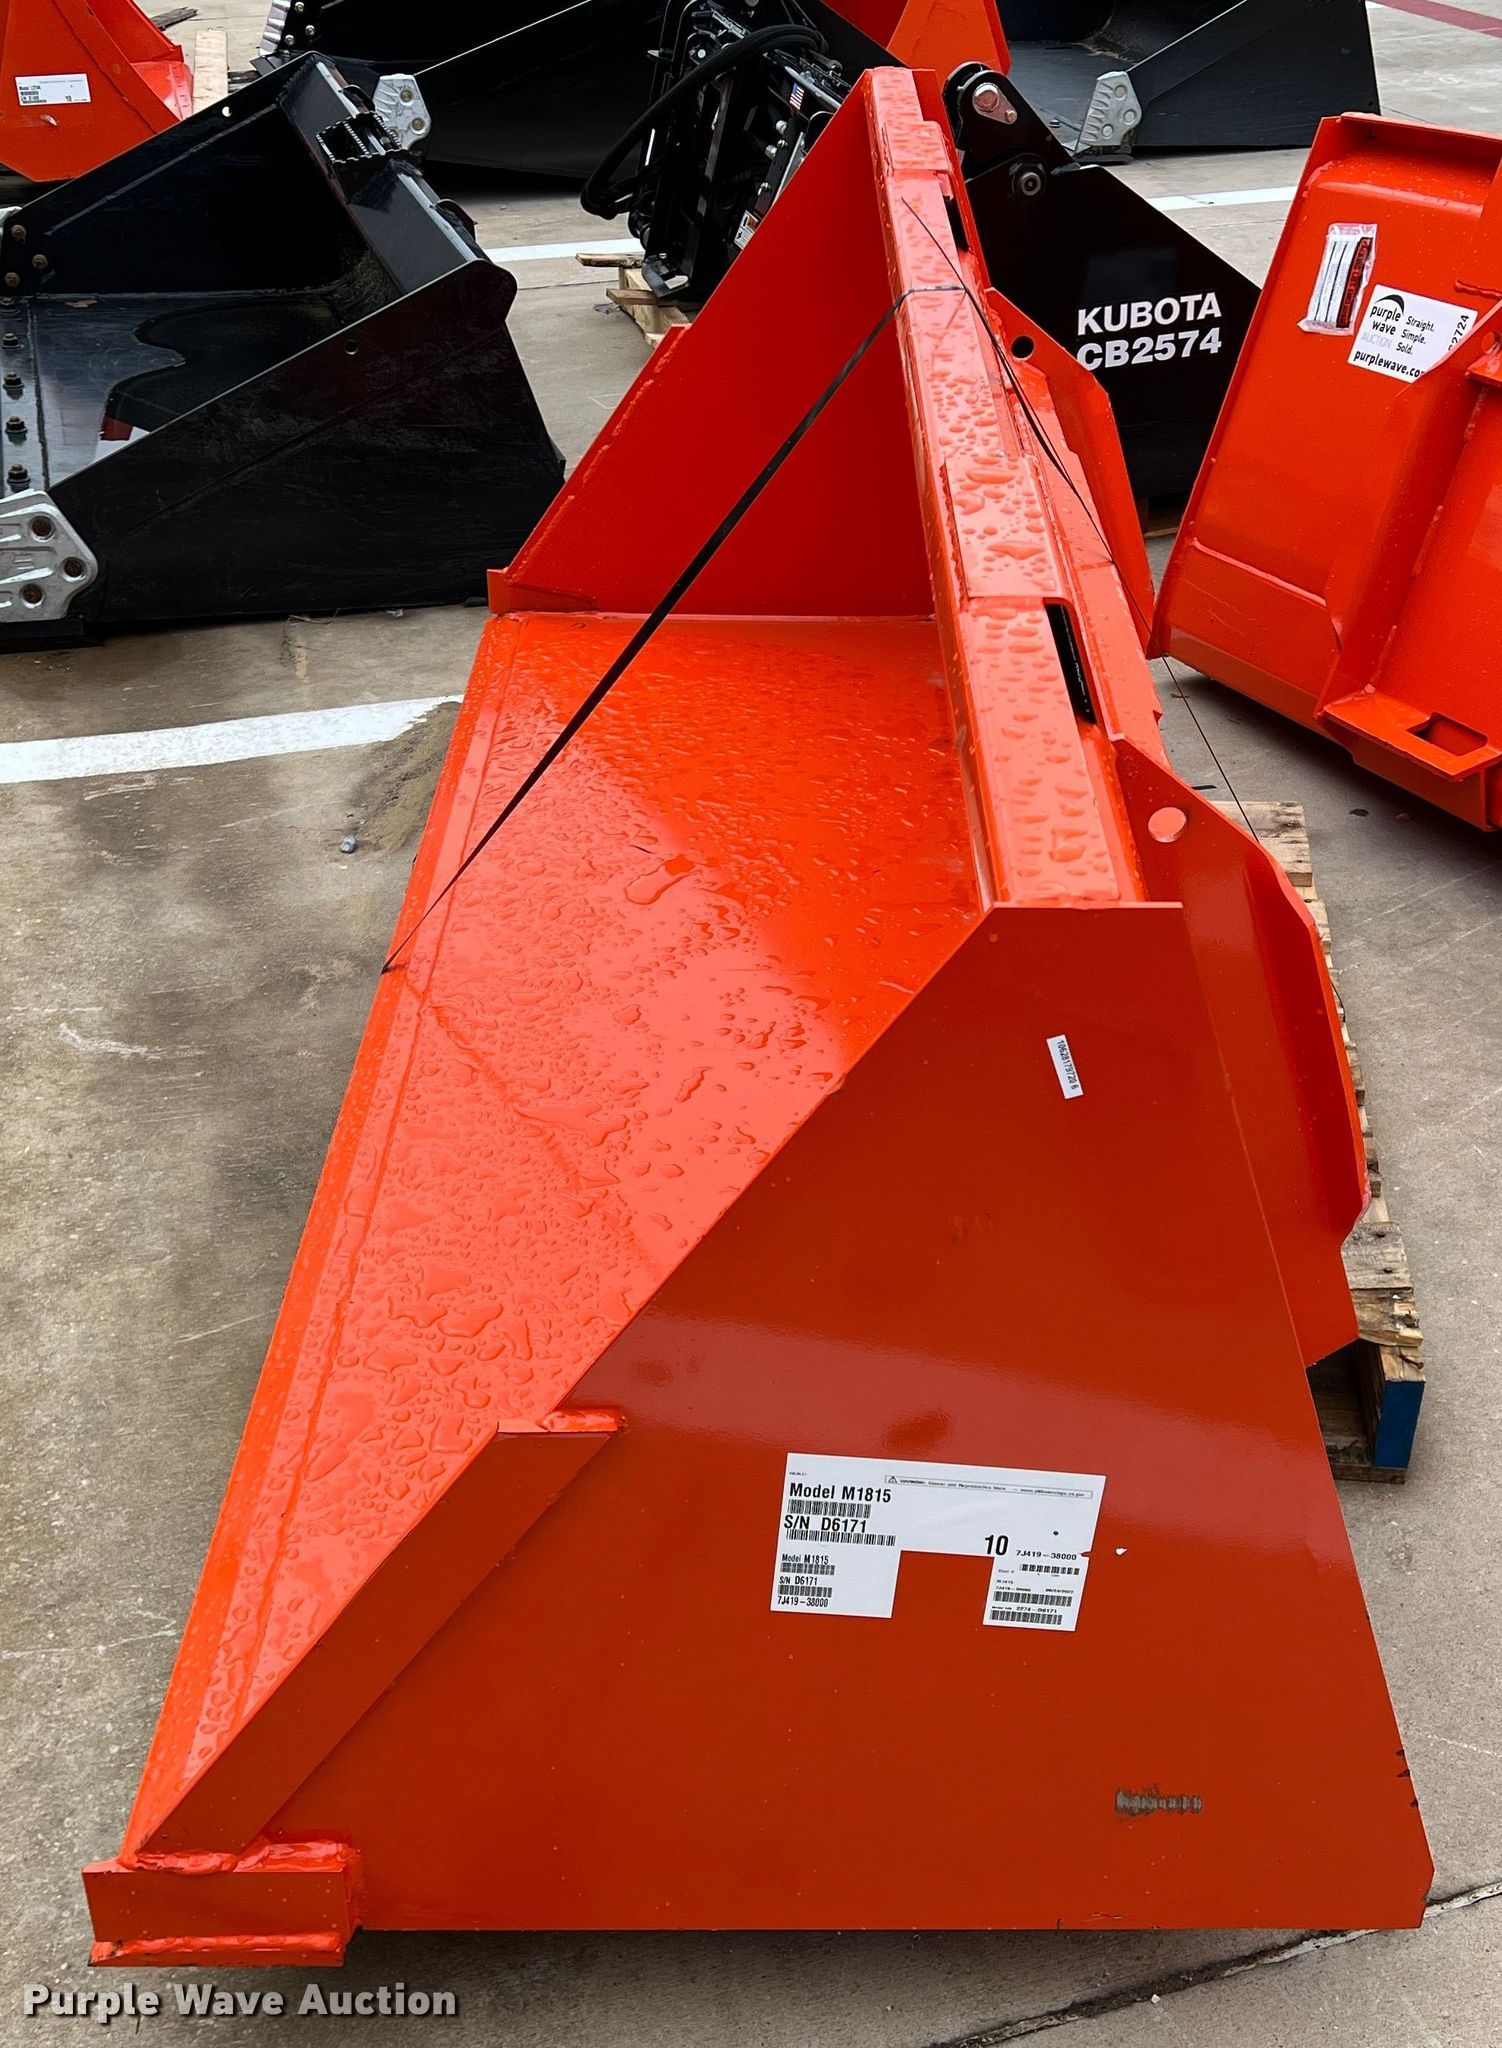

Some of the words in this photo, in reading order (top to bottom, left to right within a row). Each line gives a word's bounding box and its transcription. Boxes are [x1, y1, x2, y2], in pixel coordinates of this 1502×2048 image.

[1077, 291, 1223, 336] KUBOTA
[1369, 305, 1401, 322] purple
[1372, 321, 1396, 335] wave
[1406, 315, 1435, 332] Straight.
[1361, 331, 1391, 349] AUCTION
[1401, 329, 1426, 344] Simple.
[1076, 327, 1222, 371] CB2574
[1396, 342, 1412, 355] Sold.
[1353, 350, 1425, 378] purplewave.co
[789, 1482, 836, 1499] Model
[841, 1486, 891, 1503] M1815
[783, 1514, 811, 1530] S/N
[821, 1517, 867, 1533] D6171
[984, 1534, 1009, 1556] 10
[781, 1553, 802, 1563] Model
[804, 1554, 829, 1565] M1815
[779, 1575, 791, 1585] S/N
[794, 1576, 818, 1586] D6171
